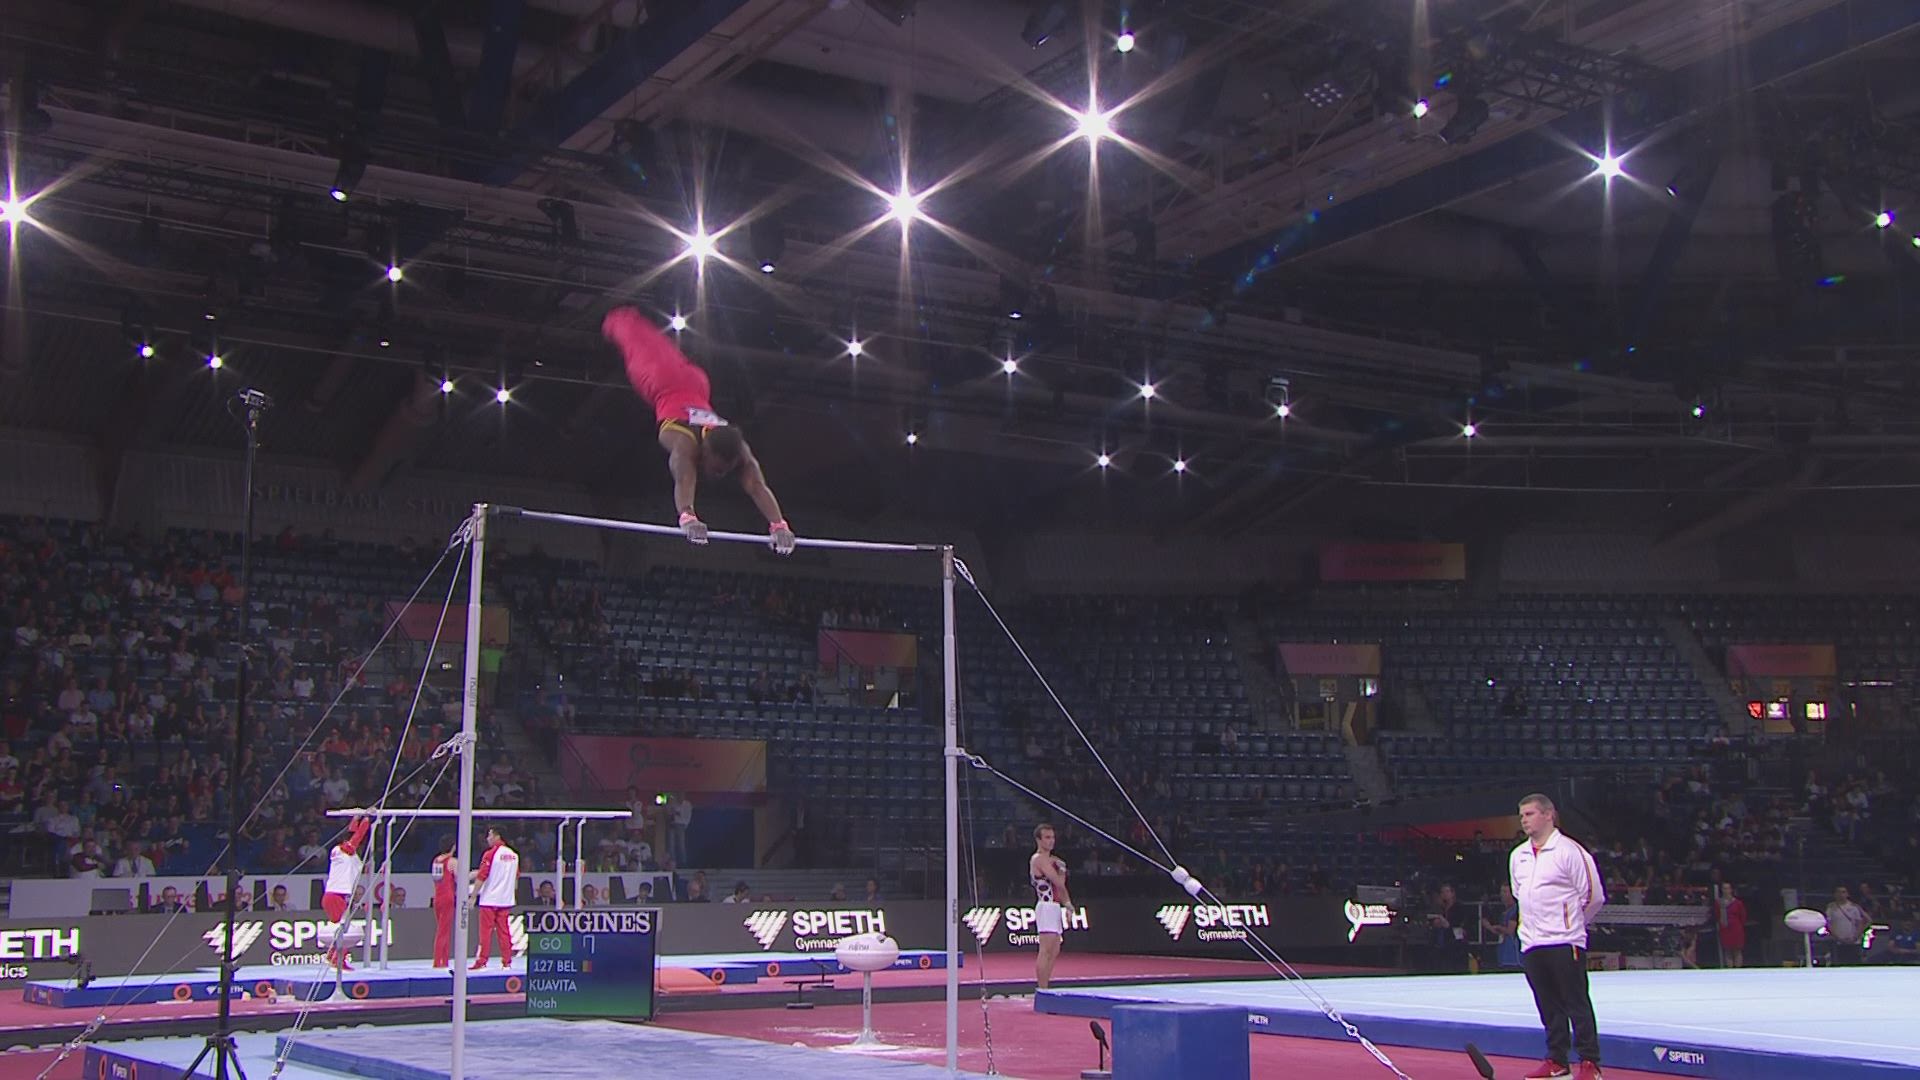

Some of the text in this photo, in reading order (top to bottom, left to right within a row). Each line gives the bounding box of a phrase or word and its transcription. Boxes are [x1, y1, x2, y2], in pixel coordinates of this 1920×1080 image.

[526, 911, 651, 933] LONGINES
[1194, 905, 1269, 926] SPIETH
[792, 910, 885, 935] SPIETH
[1198, 929, 1247, 942] Gymnastics
[539, 937, 561, 950] GO
[534, 960, 577, 972] 127 BEL
[529, 979, 577, 991] KUAVITA
[529, 997, 557, 1008] Noah
[1669, 1050, 1704, 1064] SPIETH
